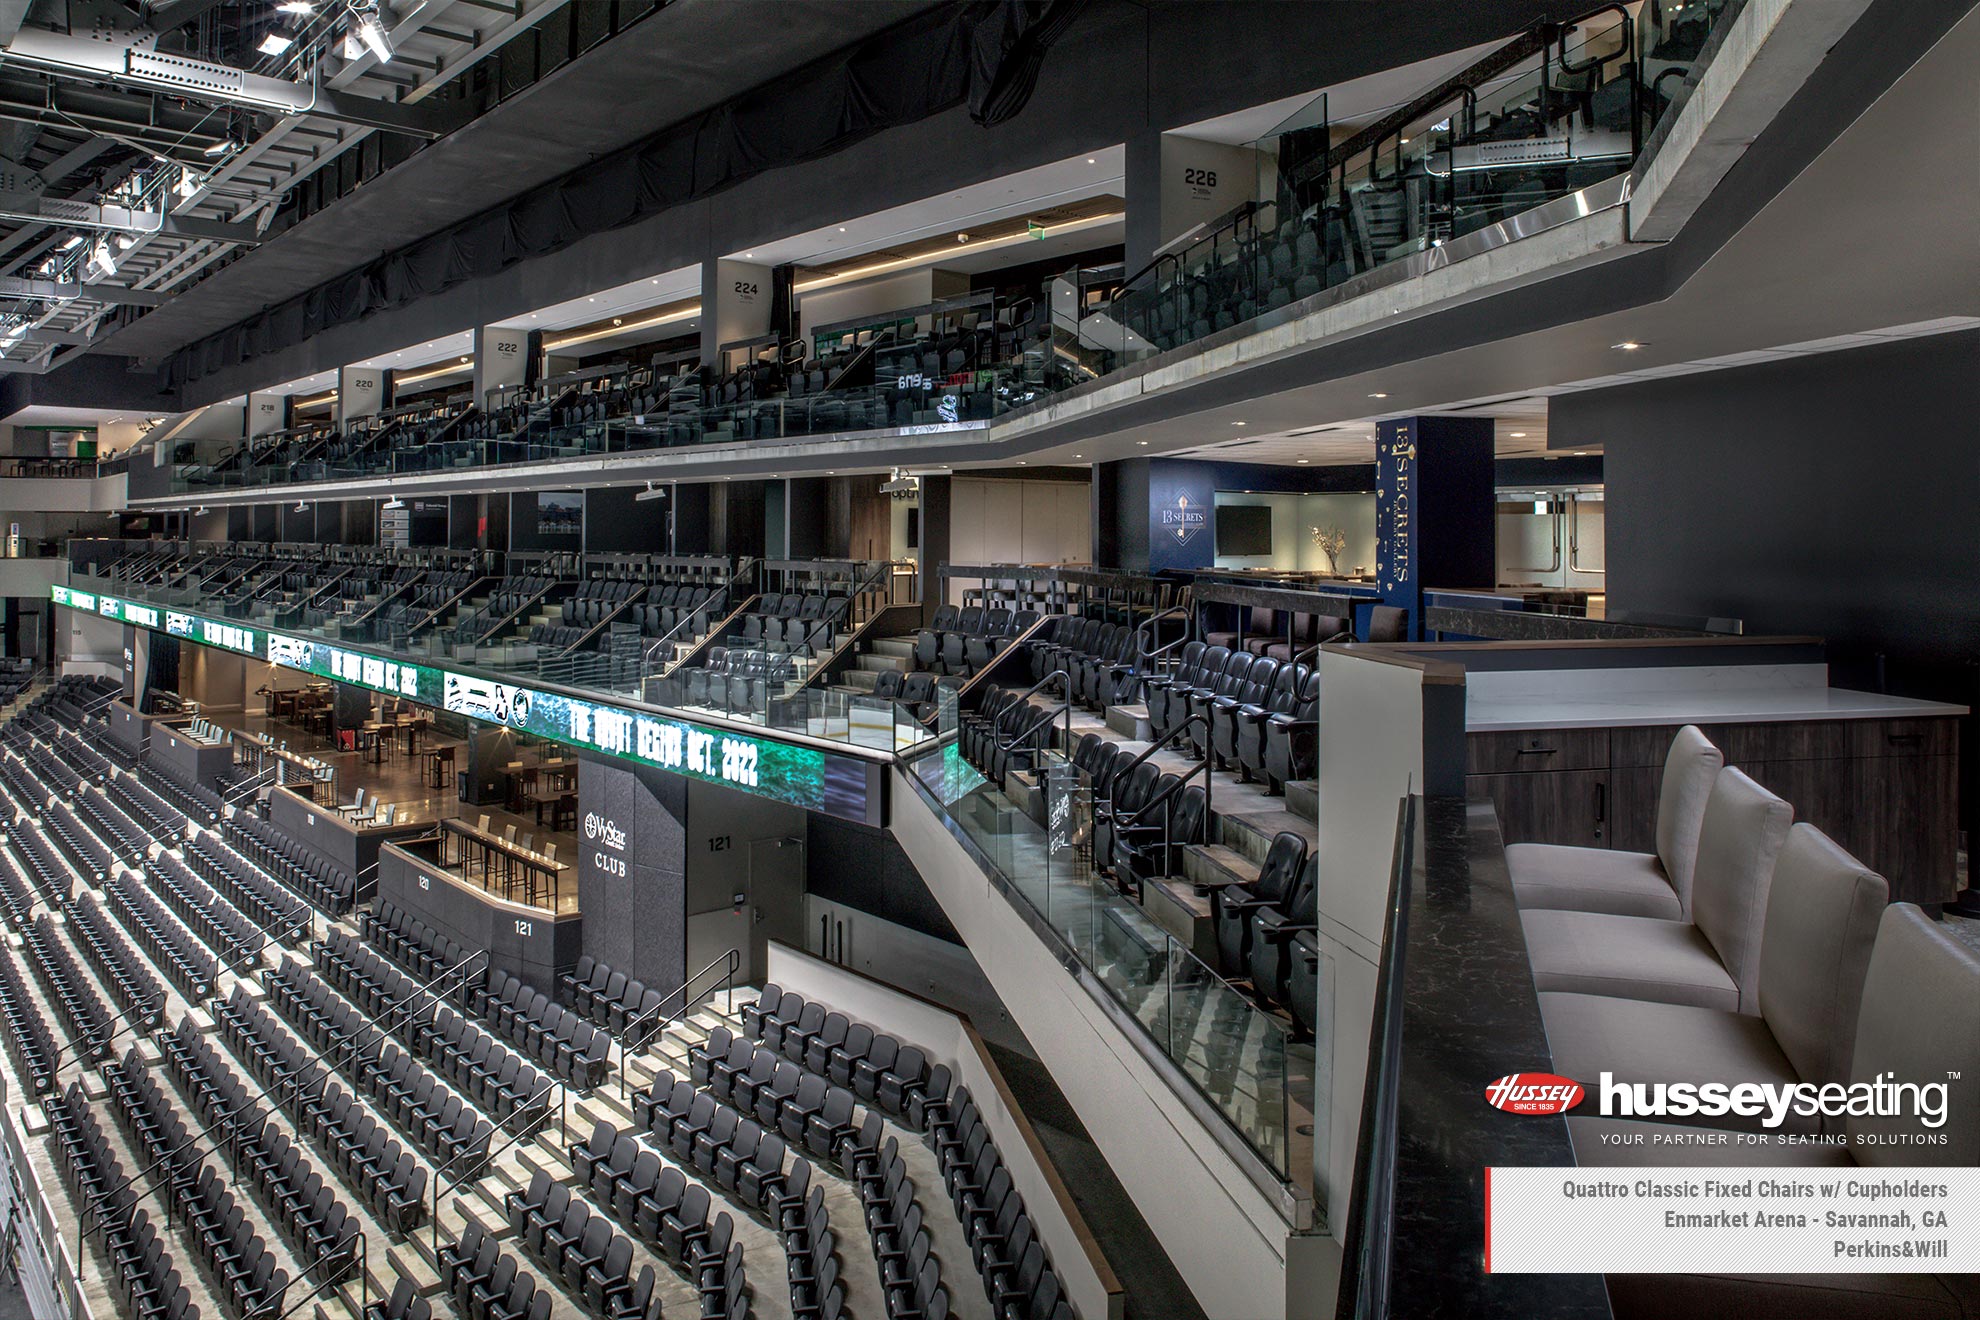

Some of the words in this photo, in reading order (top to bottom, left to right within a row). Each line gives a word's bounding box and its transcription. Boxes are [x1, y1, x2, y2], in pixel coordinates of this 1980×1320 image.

[1185, 168, 1217, 187] 226
[735, 281, 758, 294] 224
[498, 342, 517, 352] 222
[355, 380, 373, 388] 220
[1397, 426, 1409, 448] 13
[1162, 510, 1173, 524] 13
[1396, 457, 1409, 582] SECRETS
[722, 738, 759, 787] 2022
[596, 815, 626, 847] VyStar
[708, 836, 731, 851] 121
[595, 852, 626, 878] CLUB
[419, 875, 430, 891] 120
[514, 920, 532, 937] 121
